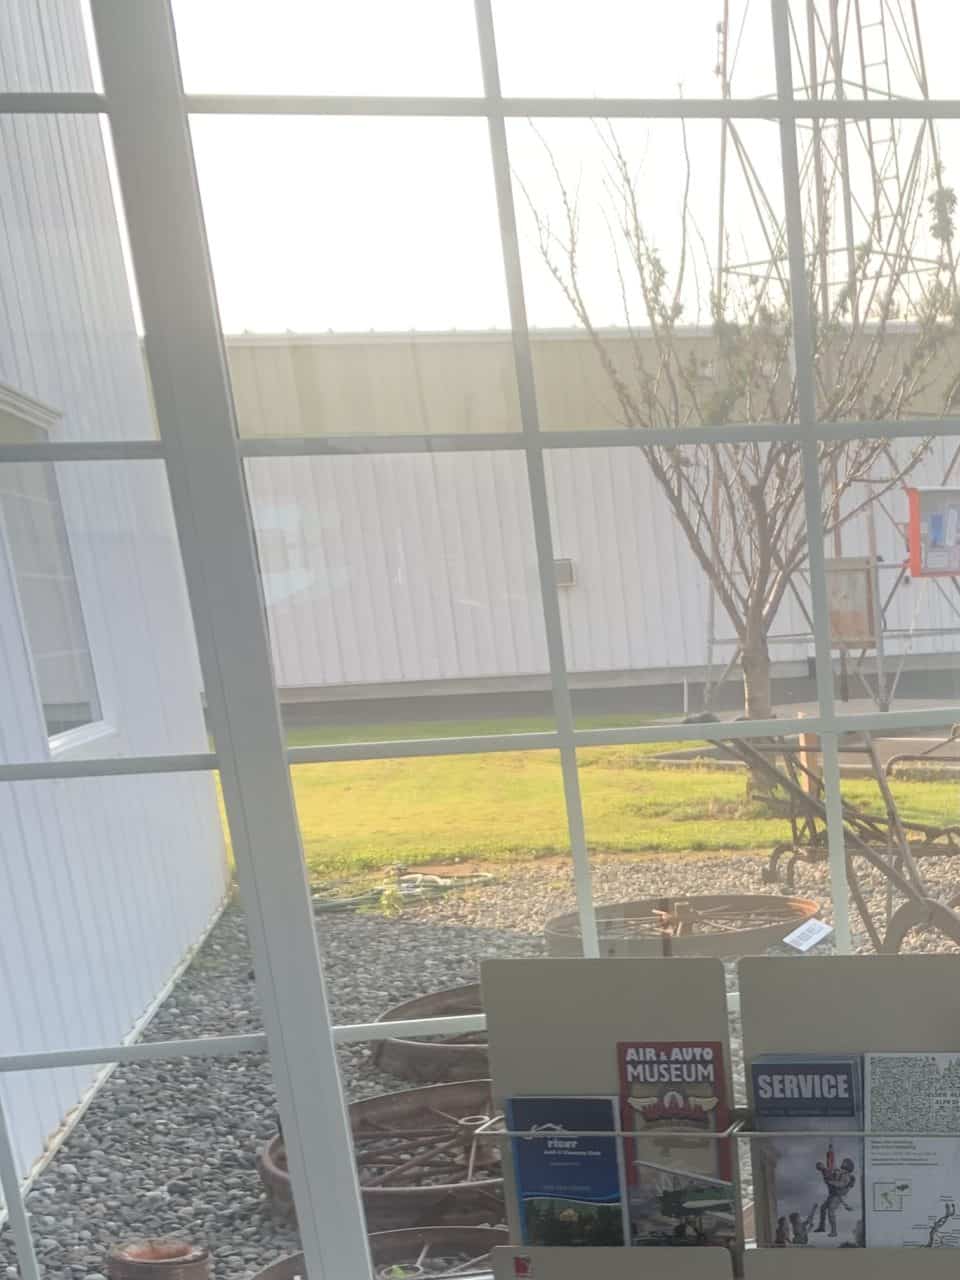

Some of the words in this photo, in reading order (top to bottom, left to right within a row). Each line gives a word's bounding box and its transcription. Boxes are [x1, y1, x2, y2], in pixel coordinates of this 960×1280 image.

[625, 1047, 657, 1061] AIR
[670, 1047, 713, 1061] AUTO
[627, 1063, 715, 1082] MUSEUM
[757, 1074, 849, 1099] SERVICE
